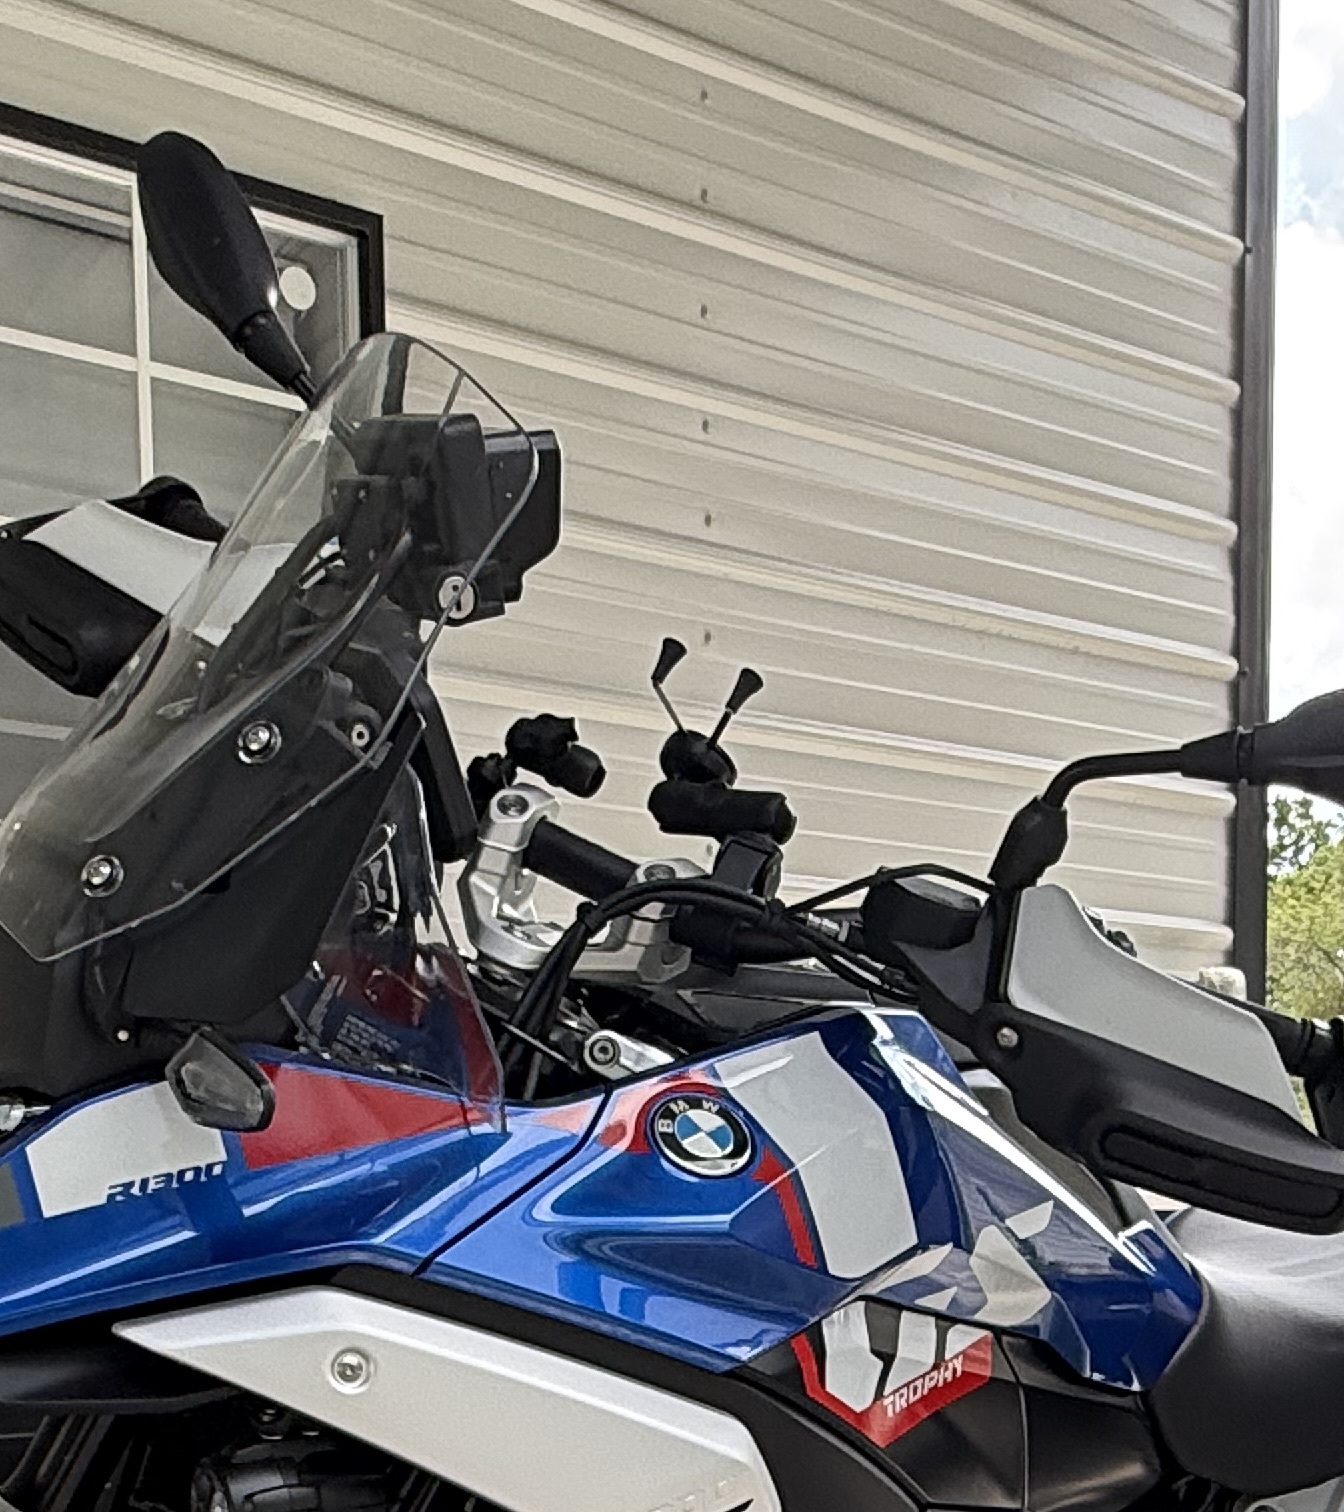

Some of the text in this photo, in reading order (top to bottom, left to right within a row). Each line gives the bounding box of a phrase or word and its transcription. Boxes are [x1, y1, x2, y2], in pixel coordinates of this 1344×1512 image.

[658, 1099, 720, 1133] BMW
[106, 1161, 226, 1202] R1300
[883, 1354, 964, 1418] TROPHY
